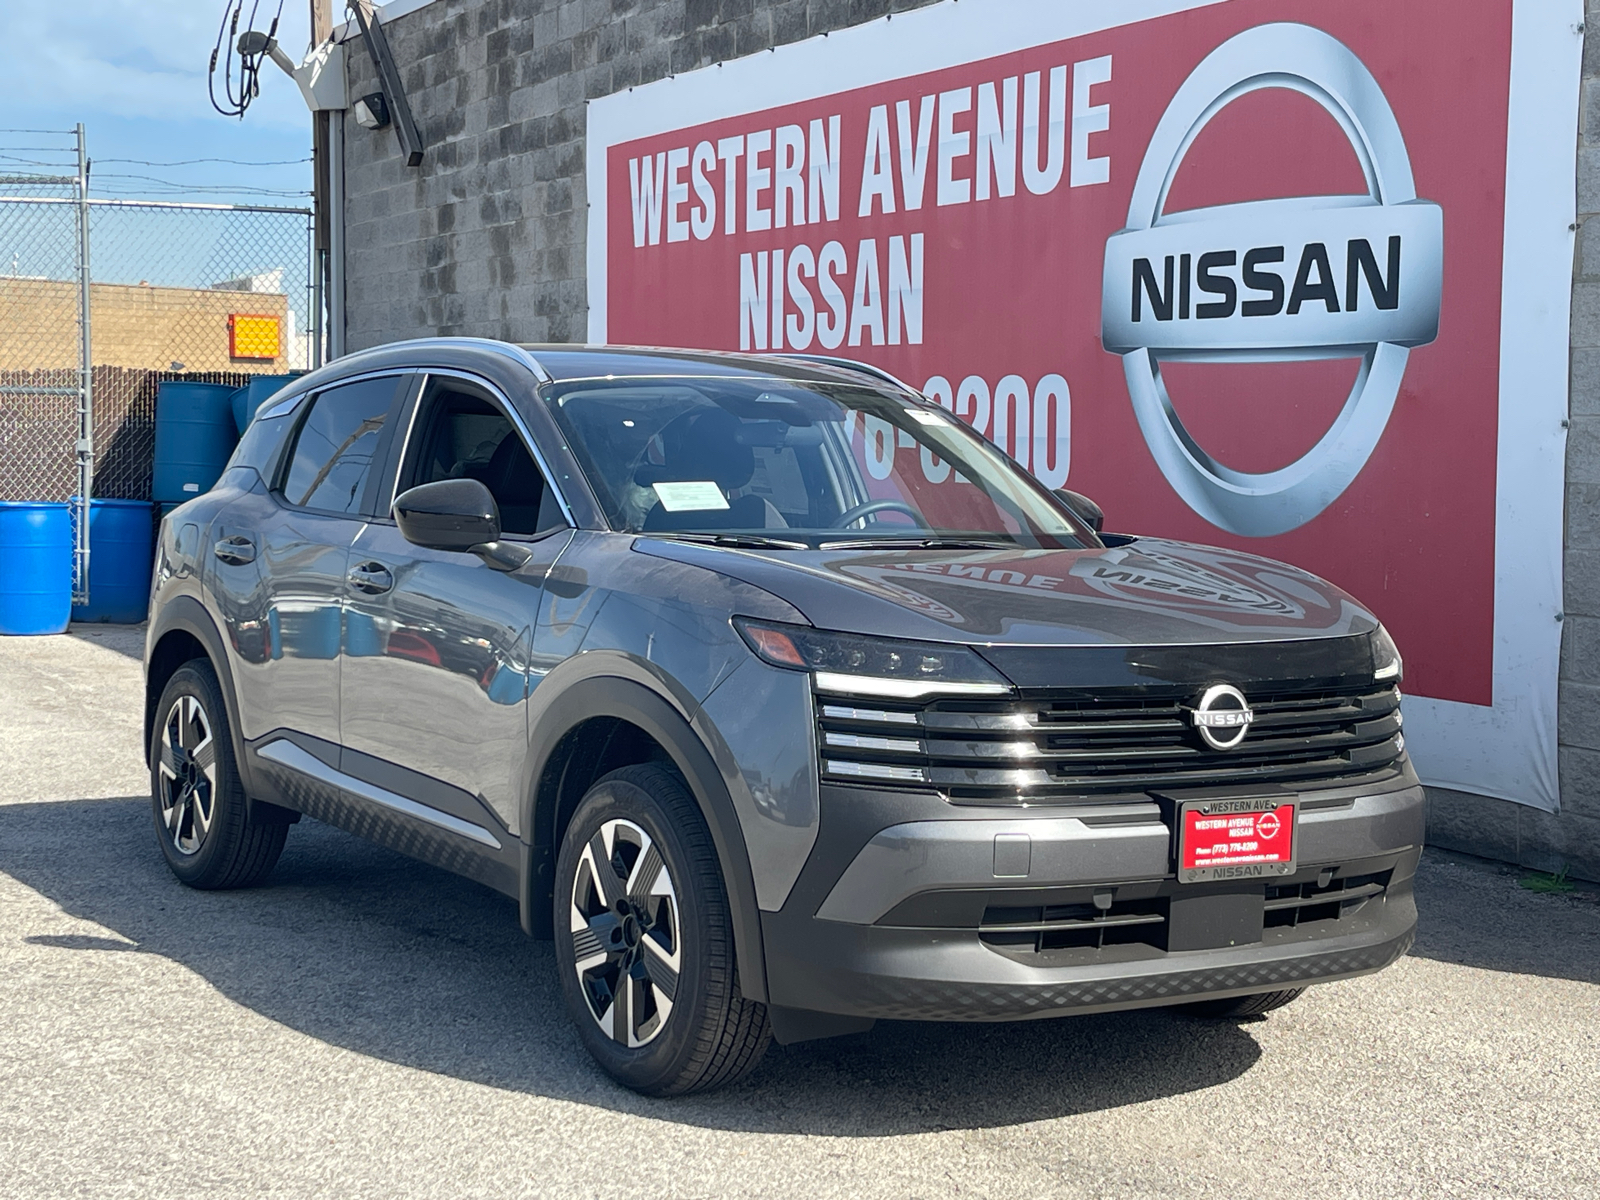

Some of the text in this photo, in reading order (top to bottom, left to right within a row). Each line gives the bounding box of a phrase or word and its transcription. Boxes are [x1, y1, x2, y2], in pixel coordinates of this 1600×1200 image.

[629, 55, 1112, 248] WESTERN AVENUE
[1131, 235, 1401, 322] NISSAN
[740, 233, 924, 351] NISSAN
[1195, 711, 1253, 725] NISSAN
[1210, 801, 1251, 812] WESTERN
[1195, 817, 1254, 830] WESTERN AVENUE
[1229, 827, 1254, 837] NISSAN
[1213, 865, 1262, 878] NISSAN
